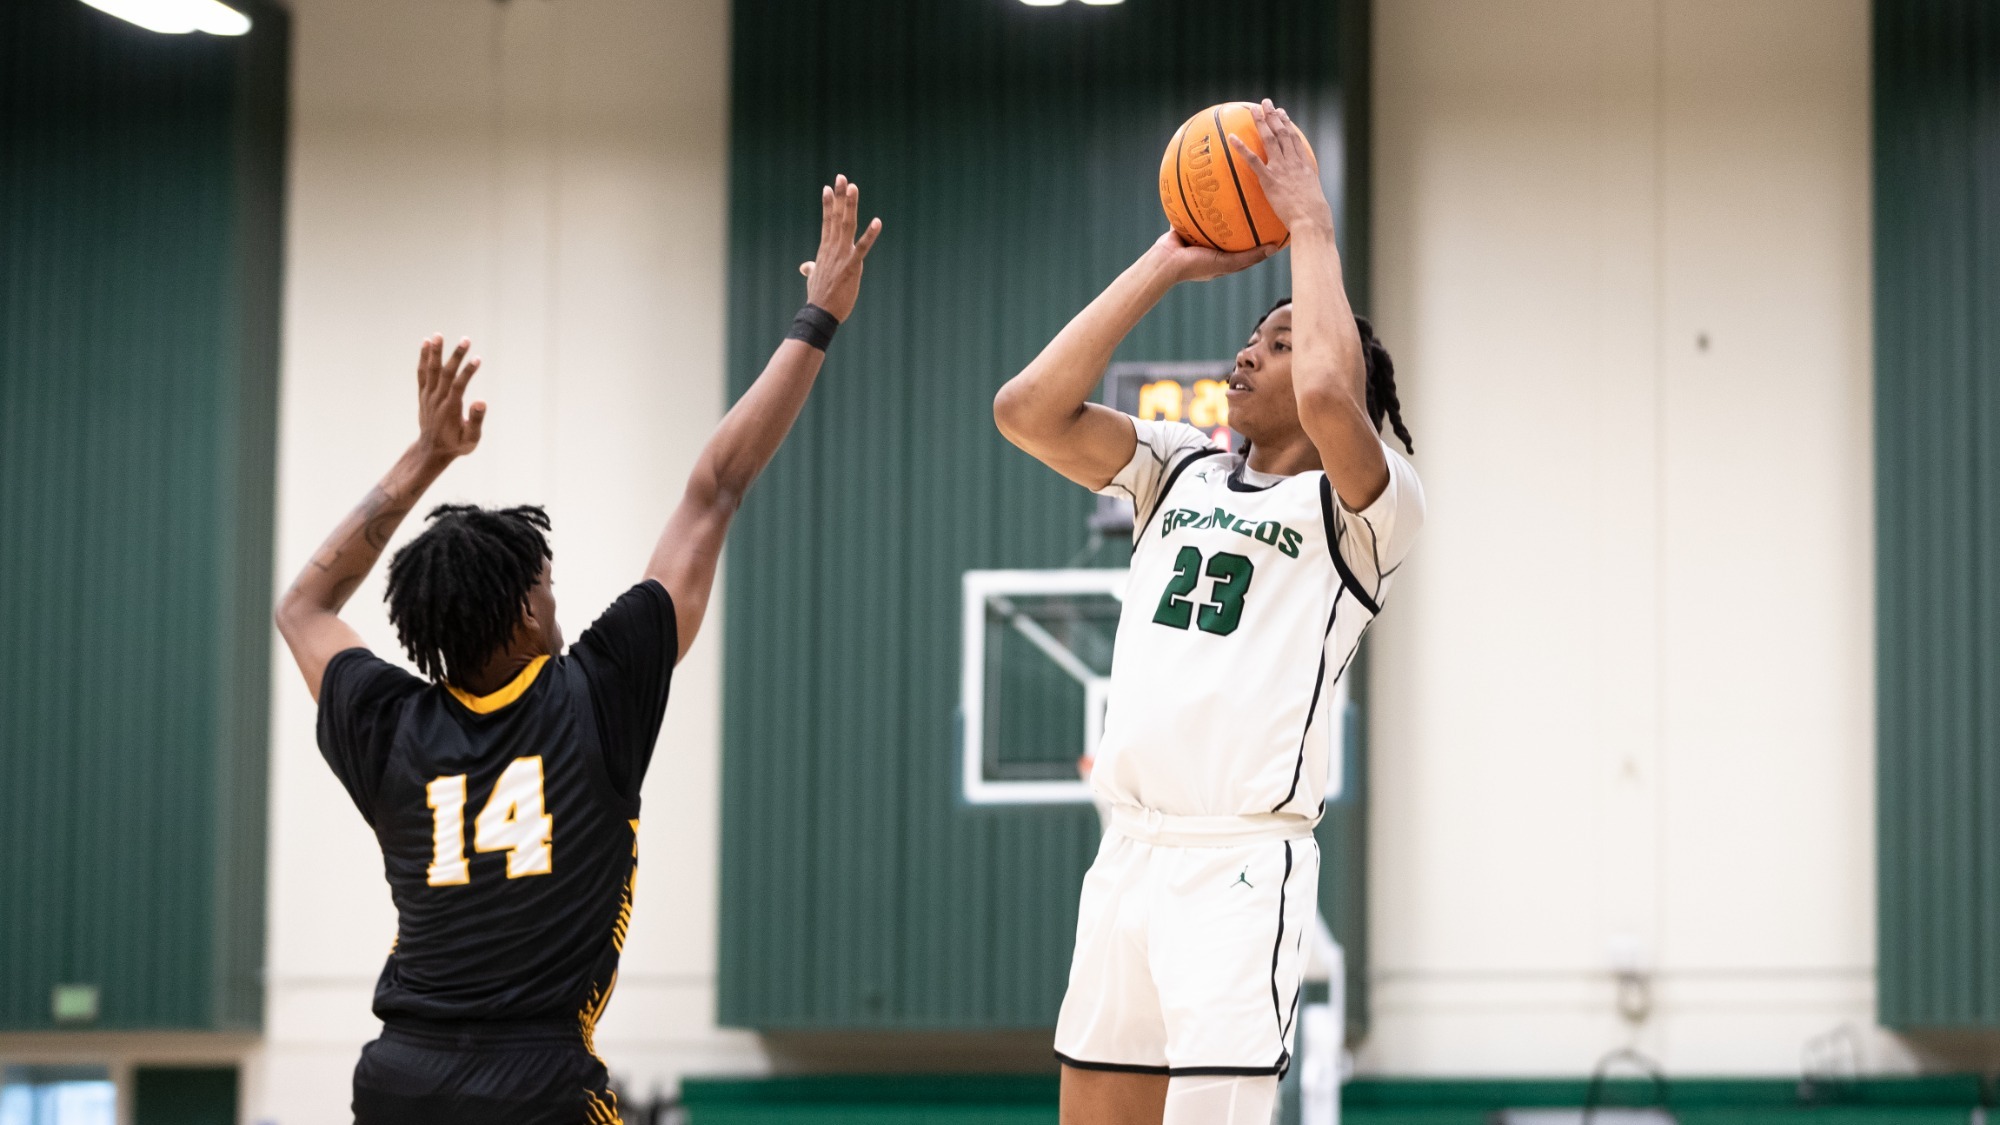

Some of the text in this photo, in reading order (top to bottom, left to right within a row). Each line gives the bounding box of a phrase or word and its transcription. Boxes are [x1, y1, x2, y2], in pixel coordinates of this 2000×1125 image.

[1187, 134, 1233, 242] Wilson
[1162, 507, 1303, 559] BRONCOS
[1152, 545, 1254, 637] 23
[426, 754, 553, 887] 14
